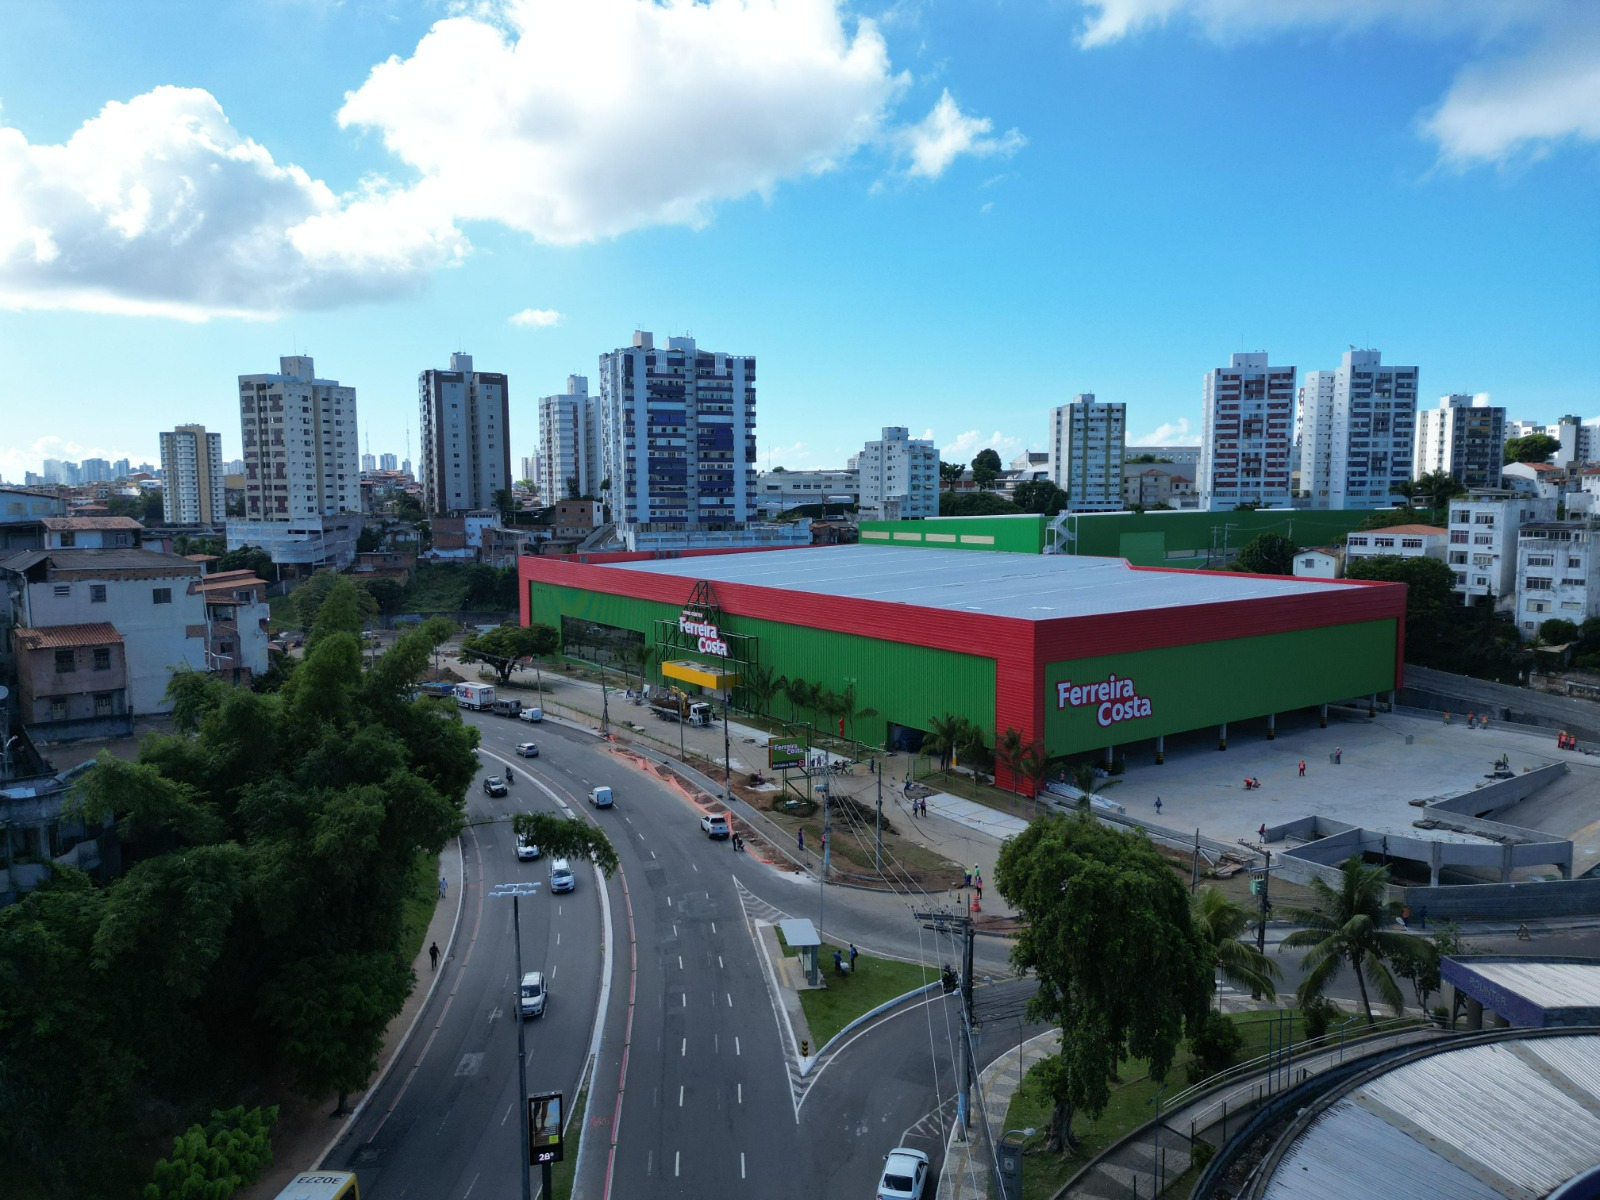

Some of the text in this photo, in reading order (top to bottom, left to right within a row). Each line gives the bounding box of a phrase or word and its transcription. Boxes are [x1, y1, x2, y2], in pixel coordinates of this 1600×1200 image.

[679, 616, 718, 639] Ferreira
[698, 637, 728, 656] Costa
[456, 685, 474, 699] FedEx
[1057, 674, 1134, 708] Ferreira
[1097, 696, 1151, 727] Costa
[774, 743, 798, 751] Ferreira
[297, 1176, 343, 1184] 30273
